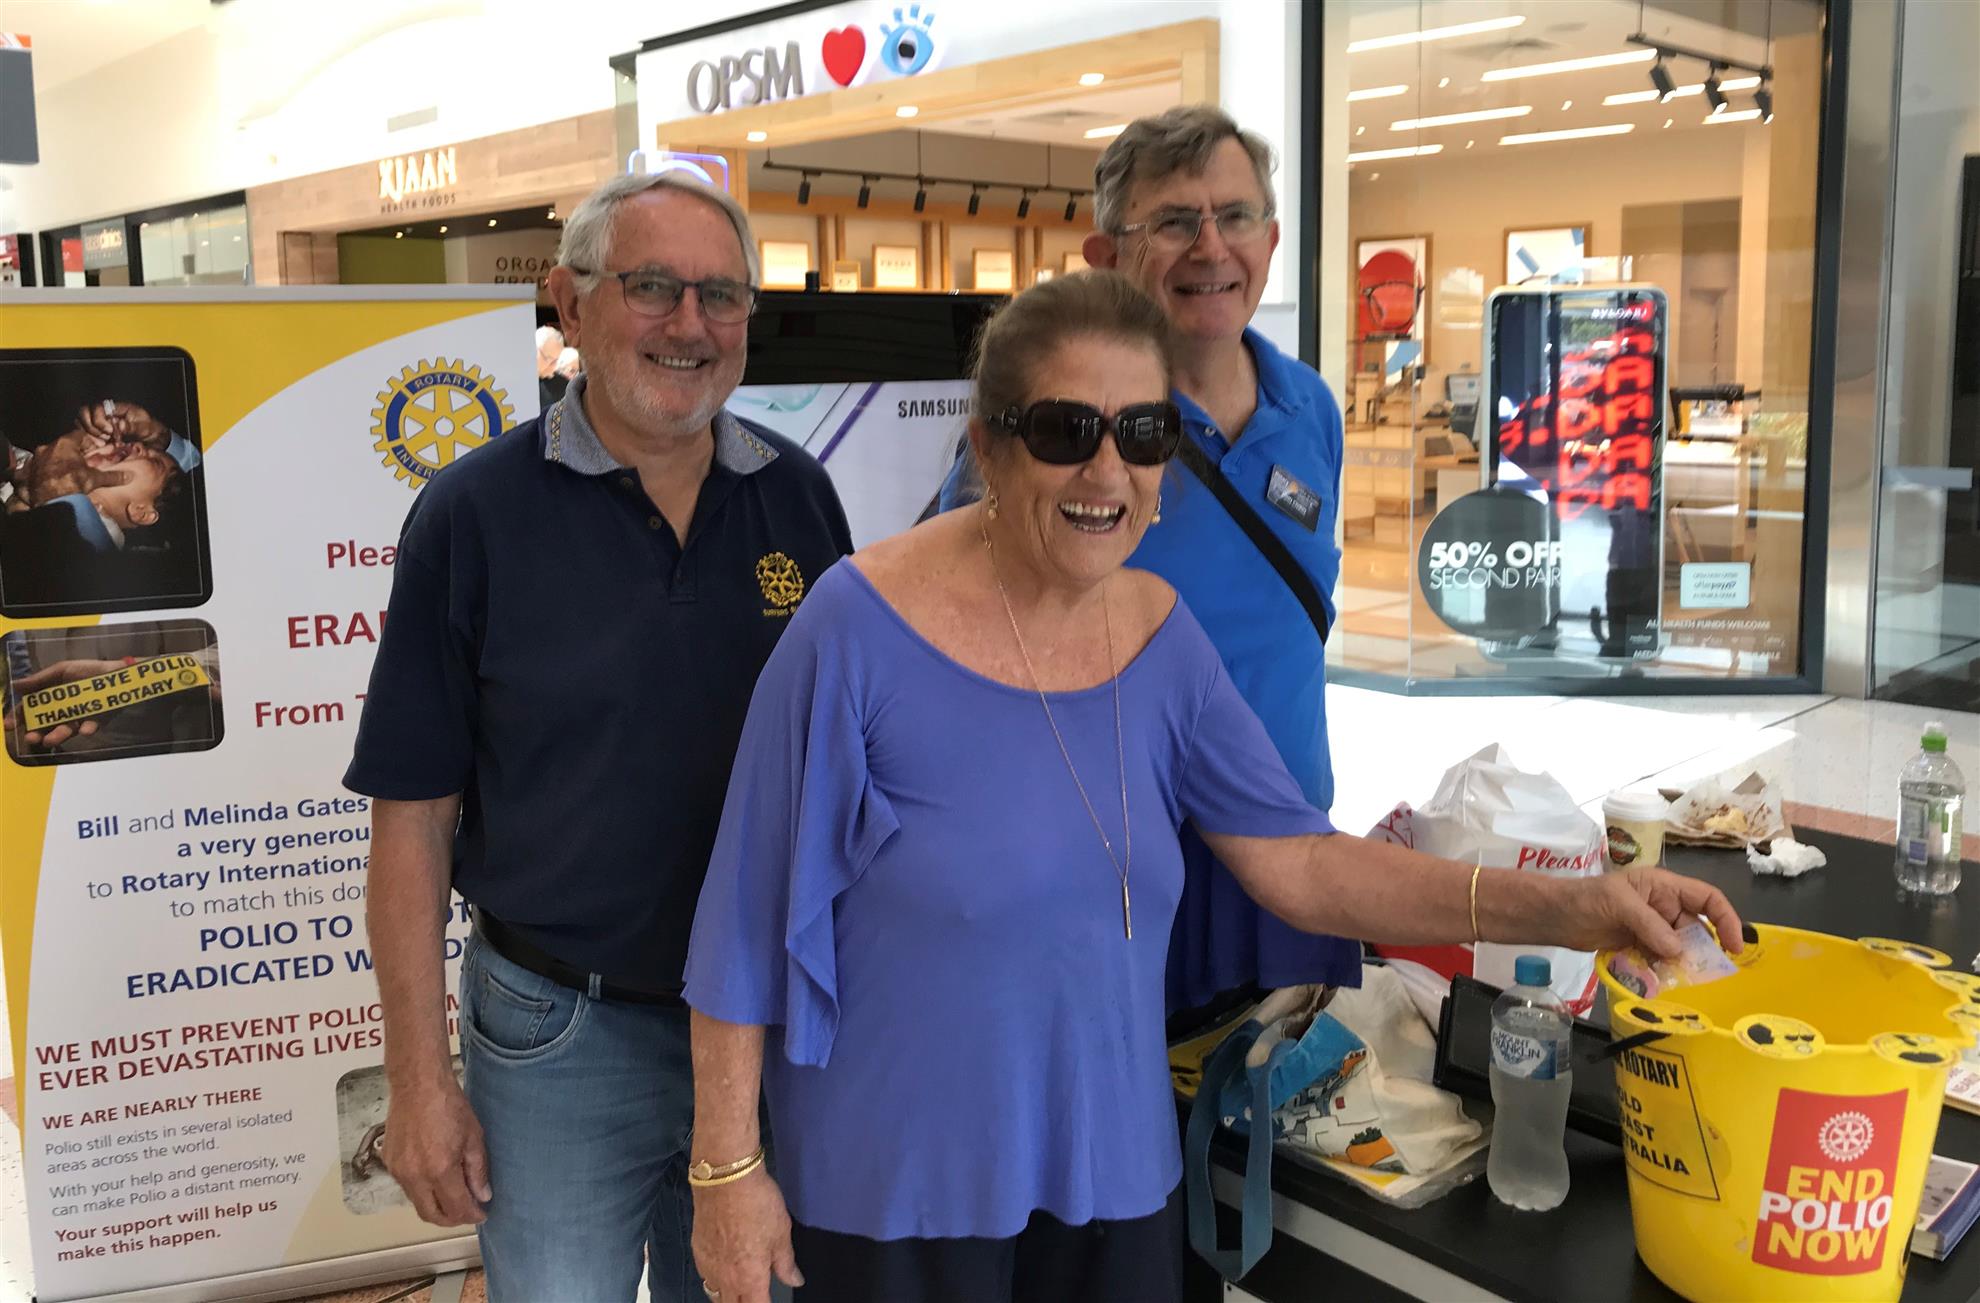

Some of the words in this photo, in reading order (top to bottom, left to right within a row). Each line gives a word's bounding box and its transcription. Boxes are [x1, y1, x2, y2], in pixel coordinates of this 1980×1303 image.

[687, 40, 804, 114] OPSM
[381, 200, 418, 214] HEALTH
[422, 192, 457, 208] FOODS
[414, 374, 471, 390] ROTARY
[898, 397, 970, 418] SAMSUN
[1428, 541, 1498, 569] 50%
[1430, 567, 1521, 590] SECOND
[1525, 567, 1562, 589] PAIR
[27, 669, 132, 708] GOOD-BYE
[137, 656, 197, 679] POLIO
[35, 698, 103, 726] THANKS
[107, 678, 175, 707] ROTARY
[255, 701, 344, 728] From
[78, 815, 119, 840] Bill
[128, 809, 174, 834] and
[184, 801, 289, 827] Melinda
[297, 797, 369, 818] Gates
[177, 843, 192, 857] a
[201, 836, 256, 857] very
[265, 827, 370, 855] generou
[86, 882, 113, 899] to
[122, 870, 210, 892] Rotary
[170, 901, 195, 918] to
[204, 890, 275, 915] match
[284, 886, 324, 907] this
[200, 920, 298, 952] POLIO
[308, 915, 353, 941] TO
[127, 953, 334, 999] ERADICATED
[36, 1043, 80, 1065] WE
[91, 1028, 172, 1059] MUST
[181, 1014, 300, 1045] PREVENT
[309, 1003, 384, 1031] POLIO
[39, 1065, 108, 1091] EVER
[118, 1039, 304, 1081] DEVASTATING
[314, 1028, 382, 1055] LIVES
[1624, 1047, 1679, 1090] ROTARY
[42, 1114, 74, 1130] WE
[80, 1107, 118, 1126] ARE
[124, 1095, 198, 1119] NEARLY
[203, 1087, 262, 1107] THERE
[1621, 1109, 1655, 1142] AST
[45, 1141, 82, 1156] Polio
[86, 1134, 112, 1151] still
[117, 1129, 158, 1146] exists
[162, 1125, 177, 1139] in
[181, 1118, 232, 1136] several
[236, 1109, 293, 1128] isolated
[47, 1160, 87, 1174] areas
[91, 1151, 138, 1168] across
[143, 1146, 169, 1160] the
[173, 1137, 219, 1155] world.
[49, 1183, 87, 1199] With
[91, 1178, 126, 1197] your
[130, 1172, 163, 1187] help
[168, 1165, 196, 1181] and
[201, 1156, 278, 1179] generosity,
[284, 1153, 306, 1164] we
[52, 1205, 79, 1217] can
[83, 1197, 125, 1213] make
[130, 1190, 167, 1205] Polio
[171, 1189, 180, 1199] a
[184, 1179, 235, 1196] distant
[239, 1172, 301, 1189] memory.
[1786, 1165, 1885, 1203] END
[55, 1227, 97, 1242] Your
[102, 1214, 173, 1236] support
[177, 1206, 209, 1224] will
[215, 1202, 253, 1219] help
[258, 1200, 278, 1212] us
[1759, 1189, 1894, 1233] POLIO
[58, 1245, 106, 1261] make
[111, 1238, 144, 1254] this
[149, 1229, 221, 1248] happen.
[1768, 1221, 1882, 1263] NOW
